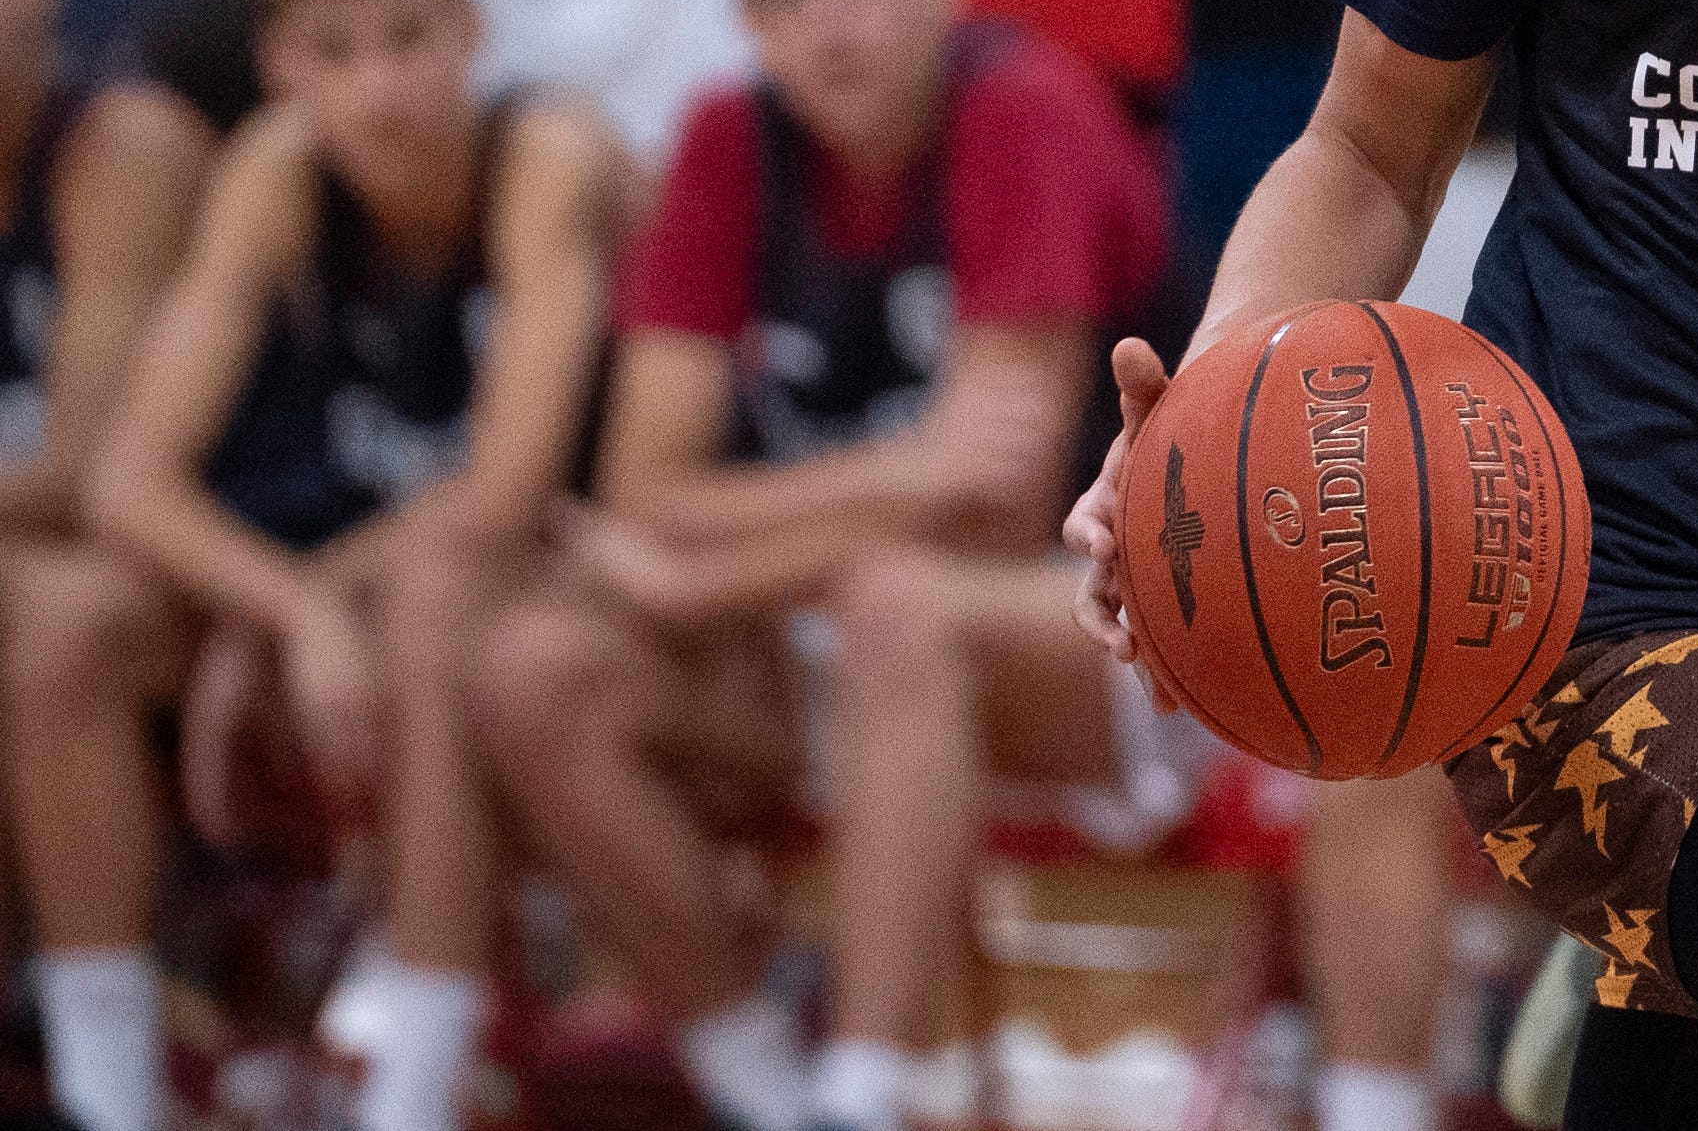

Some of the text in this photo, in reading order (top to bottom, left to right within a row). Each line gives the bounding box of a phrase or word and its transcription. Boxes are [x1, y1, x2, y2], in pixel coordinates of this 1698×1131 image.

[1299, 365, 1394, 672] SPALDING
[1445, 381, 1511, 649] LEGACY
[1536, 483, 1549, 518] GAME
